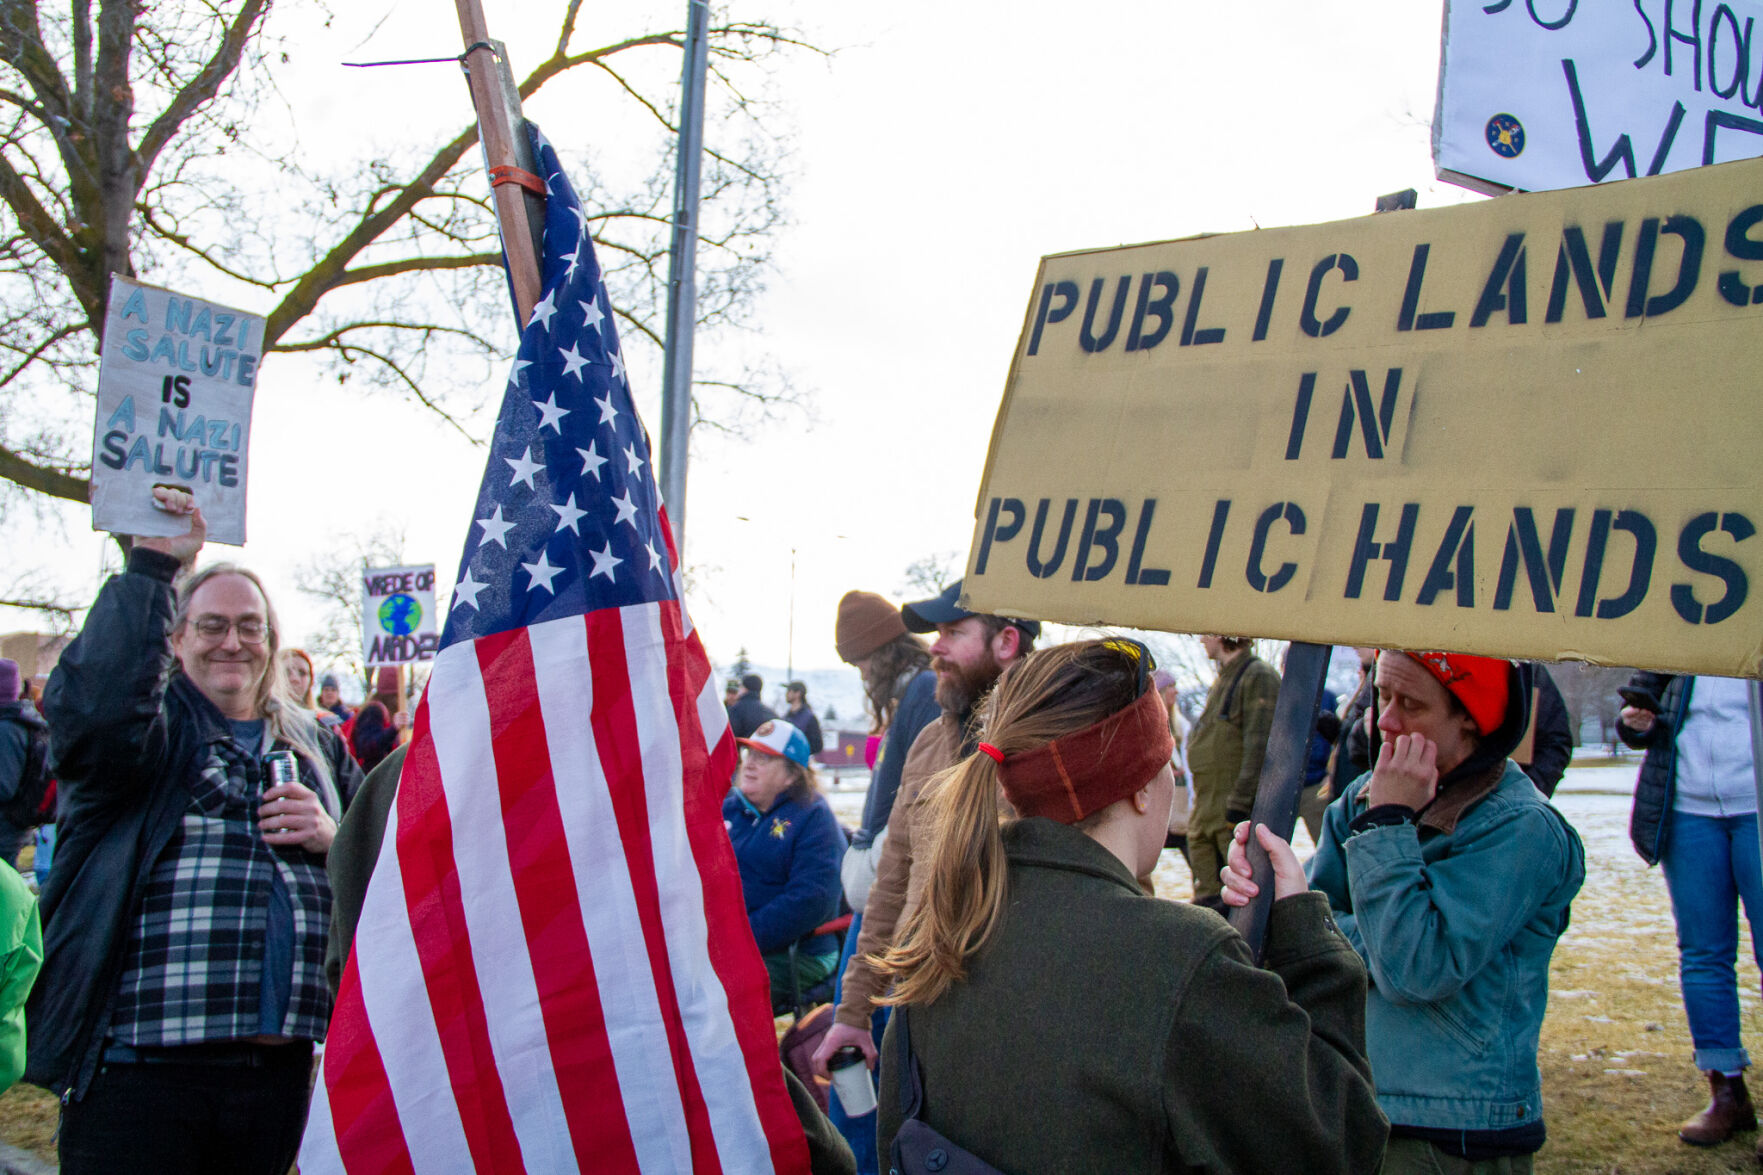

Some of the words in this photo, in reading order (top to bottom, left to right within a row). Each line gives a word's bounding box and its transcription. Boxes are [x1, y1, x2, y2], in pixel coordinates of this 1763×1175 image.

[1027, 252, 1360, 356] PUBLIC
[1397, 202, 1763, 333] LANDS
[121, 287, 149, 324] A
[165, 296, 249, 350] NAZI
[122, 328, 257, 387] SALUTE
[161, 375, 191, 409] IS
[1284, 367, 1403, 461] IN
[106, 394, 137, 434] A
[157, 406, 242, 451] NAZI
[100, 430, 239, 488] SALUTE
[415, 570, 435, 592] OP
[974, 497, 1307, 594] PUBLIC
[1343, 501, 1757, 626] HANDS
